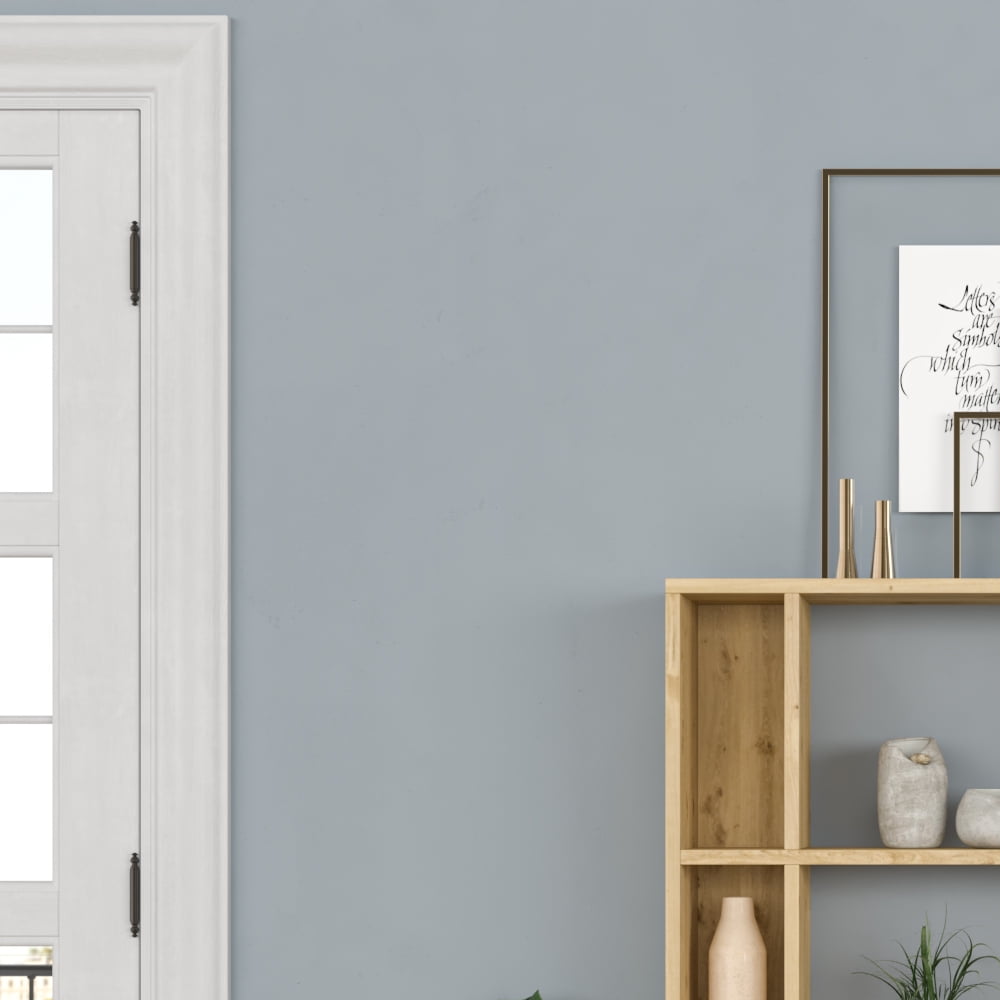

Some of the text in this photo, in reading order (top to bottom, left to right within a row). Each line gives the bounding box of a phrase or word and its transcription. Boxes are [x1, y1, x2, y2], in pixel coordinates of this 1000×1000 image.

[938, 283, 998, 316] Letters
[971, 313, 996, 330] are
[954, 369, 985, 396] turn
